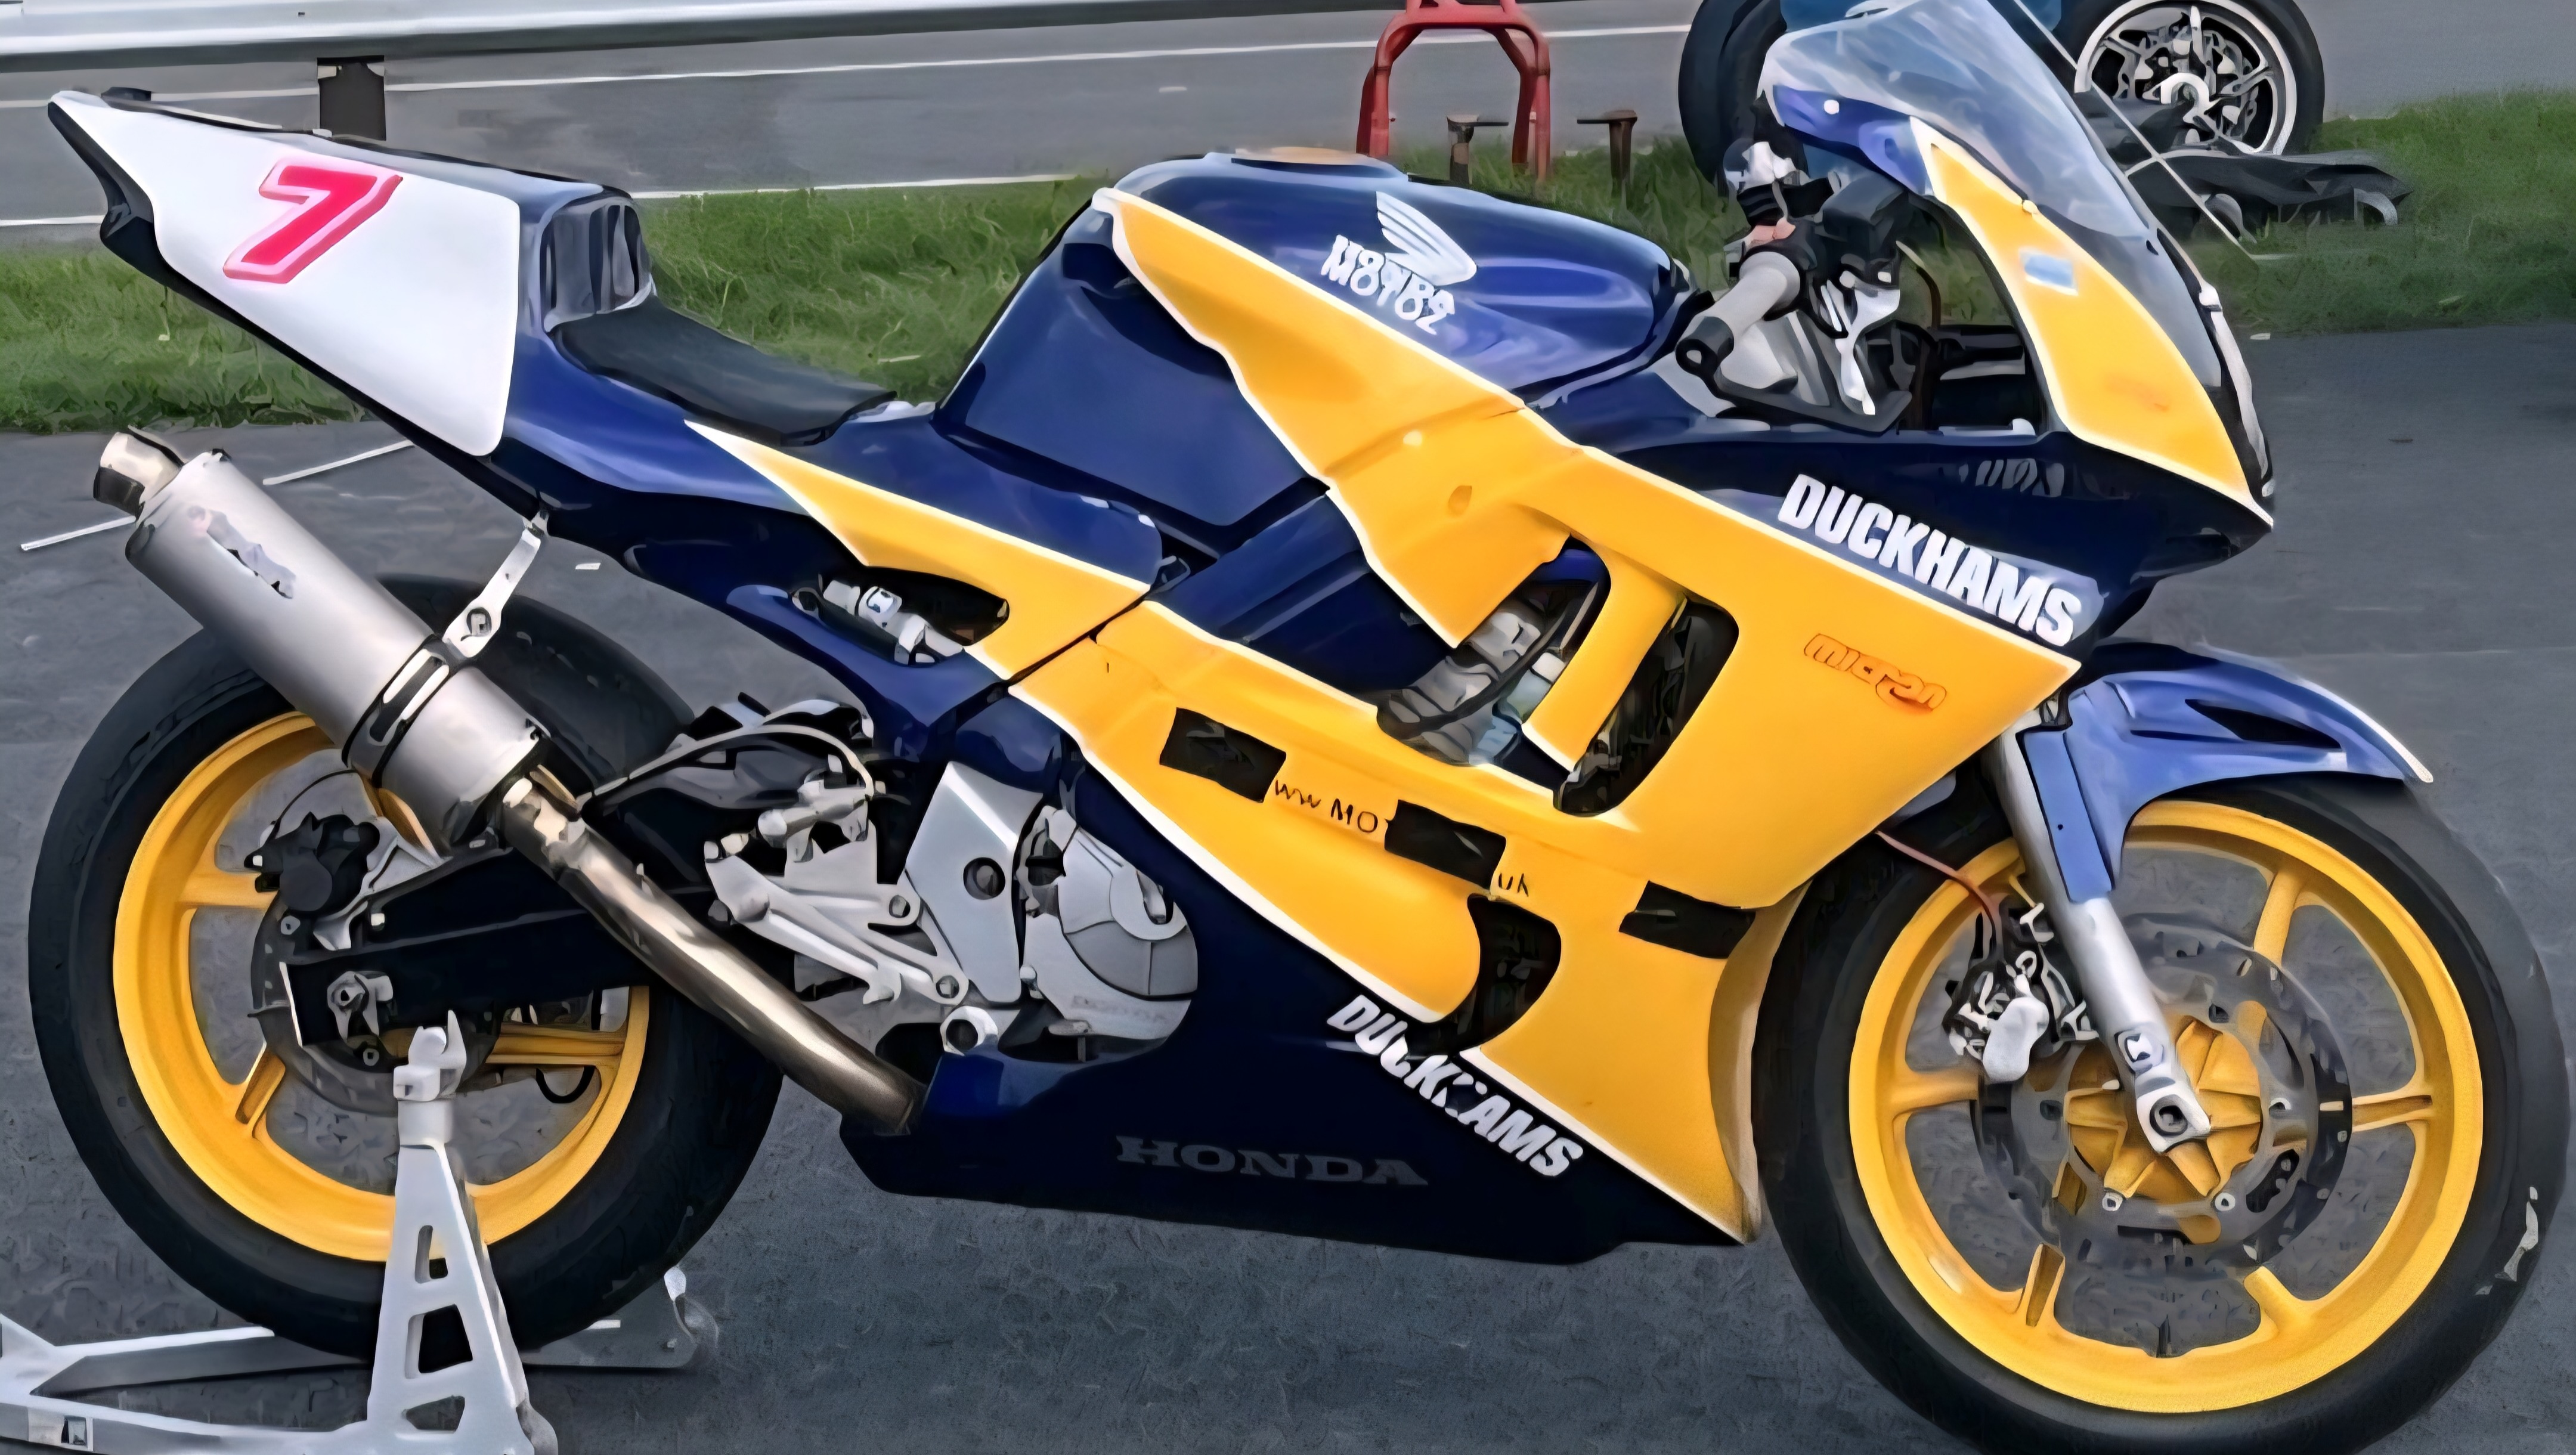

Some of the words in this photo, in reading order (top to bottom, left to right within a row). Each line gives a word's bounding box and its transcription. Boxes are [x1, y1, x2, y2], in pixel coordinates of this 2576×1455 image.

[222, 158, 403, 284] 7
[1778, 473, 2082, 646] DUCKHAMS
[1116, 1135, 1429, 1185] HONDA
